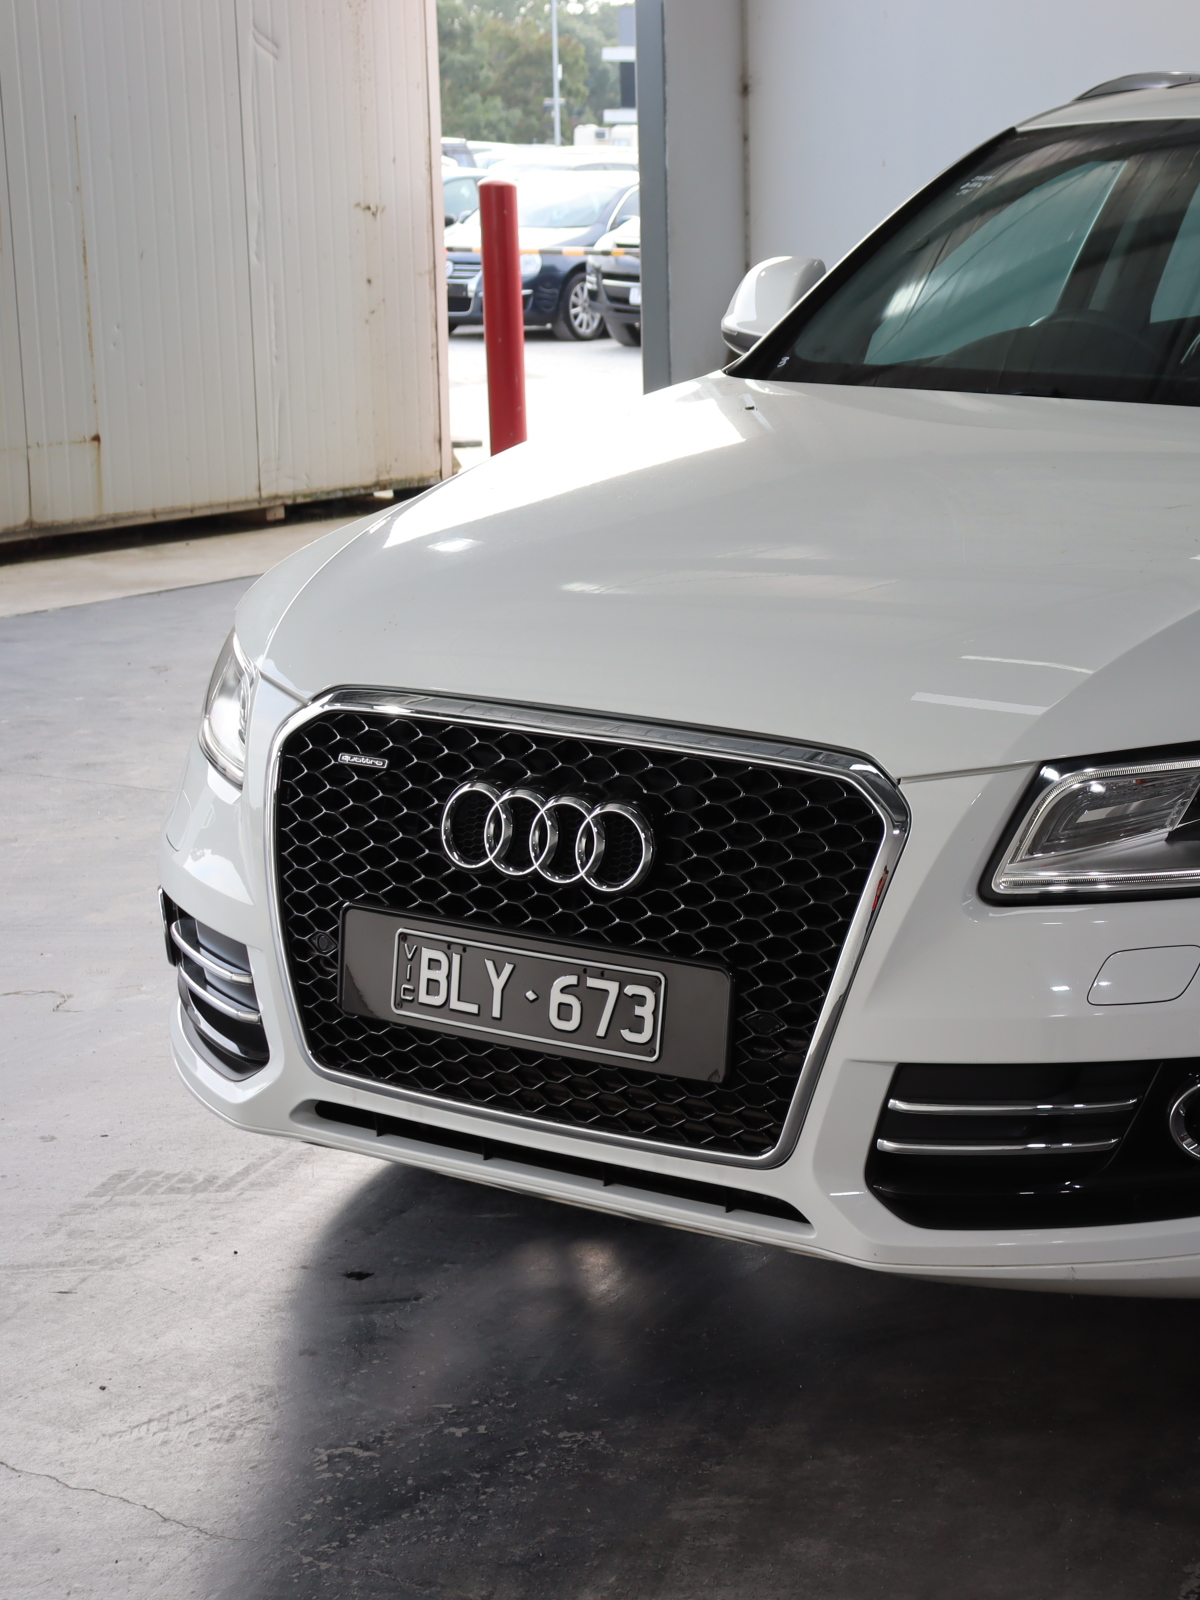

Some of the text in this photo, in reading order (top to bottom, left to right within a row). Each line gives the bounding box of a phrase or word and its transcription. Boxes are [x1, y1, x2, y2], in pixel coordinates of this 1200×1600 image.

[401, 943, 417, 1000] VIC
[418, 946, 656, 1044] BLY 673
